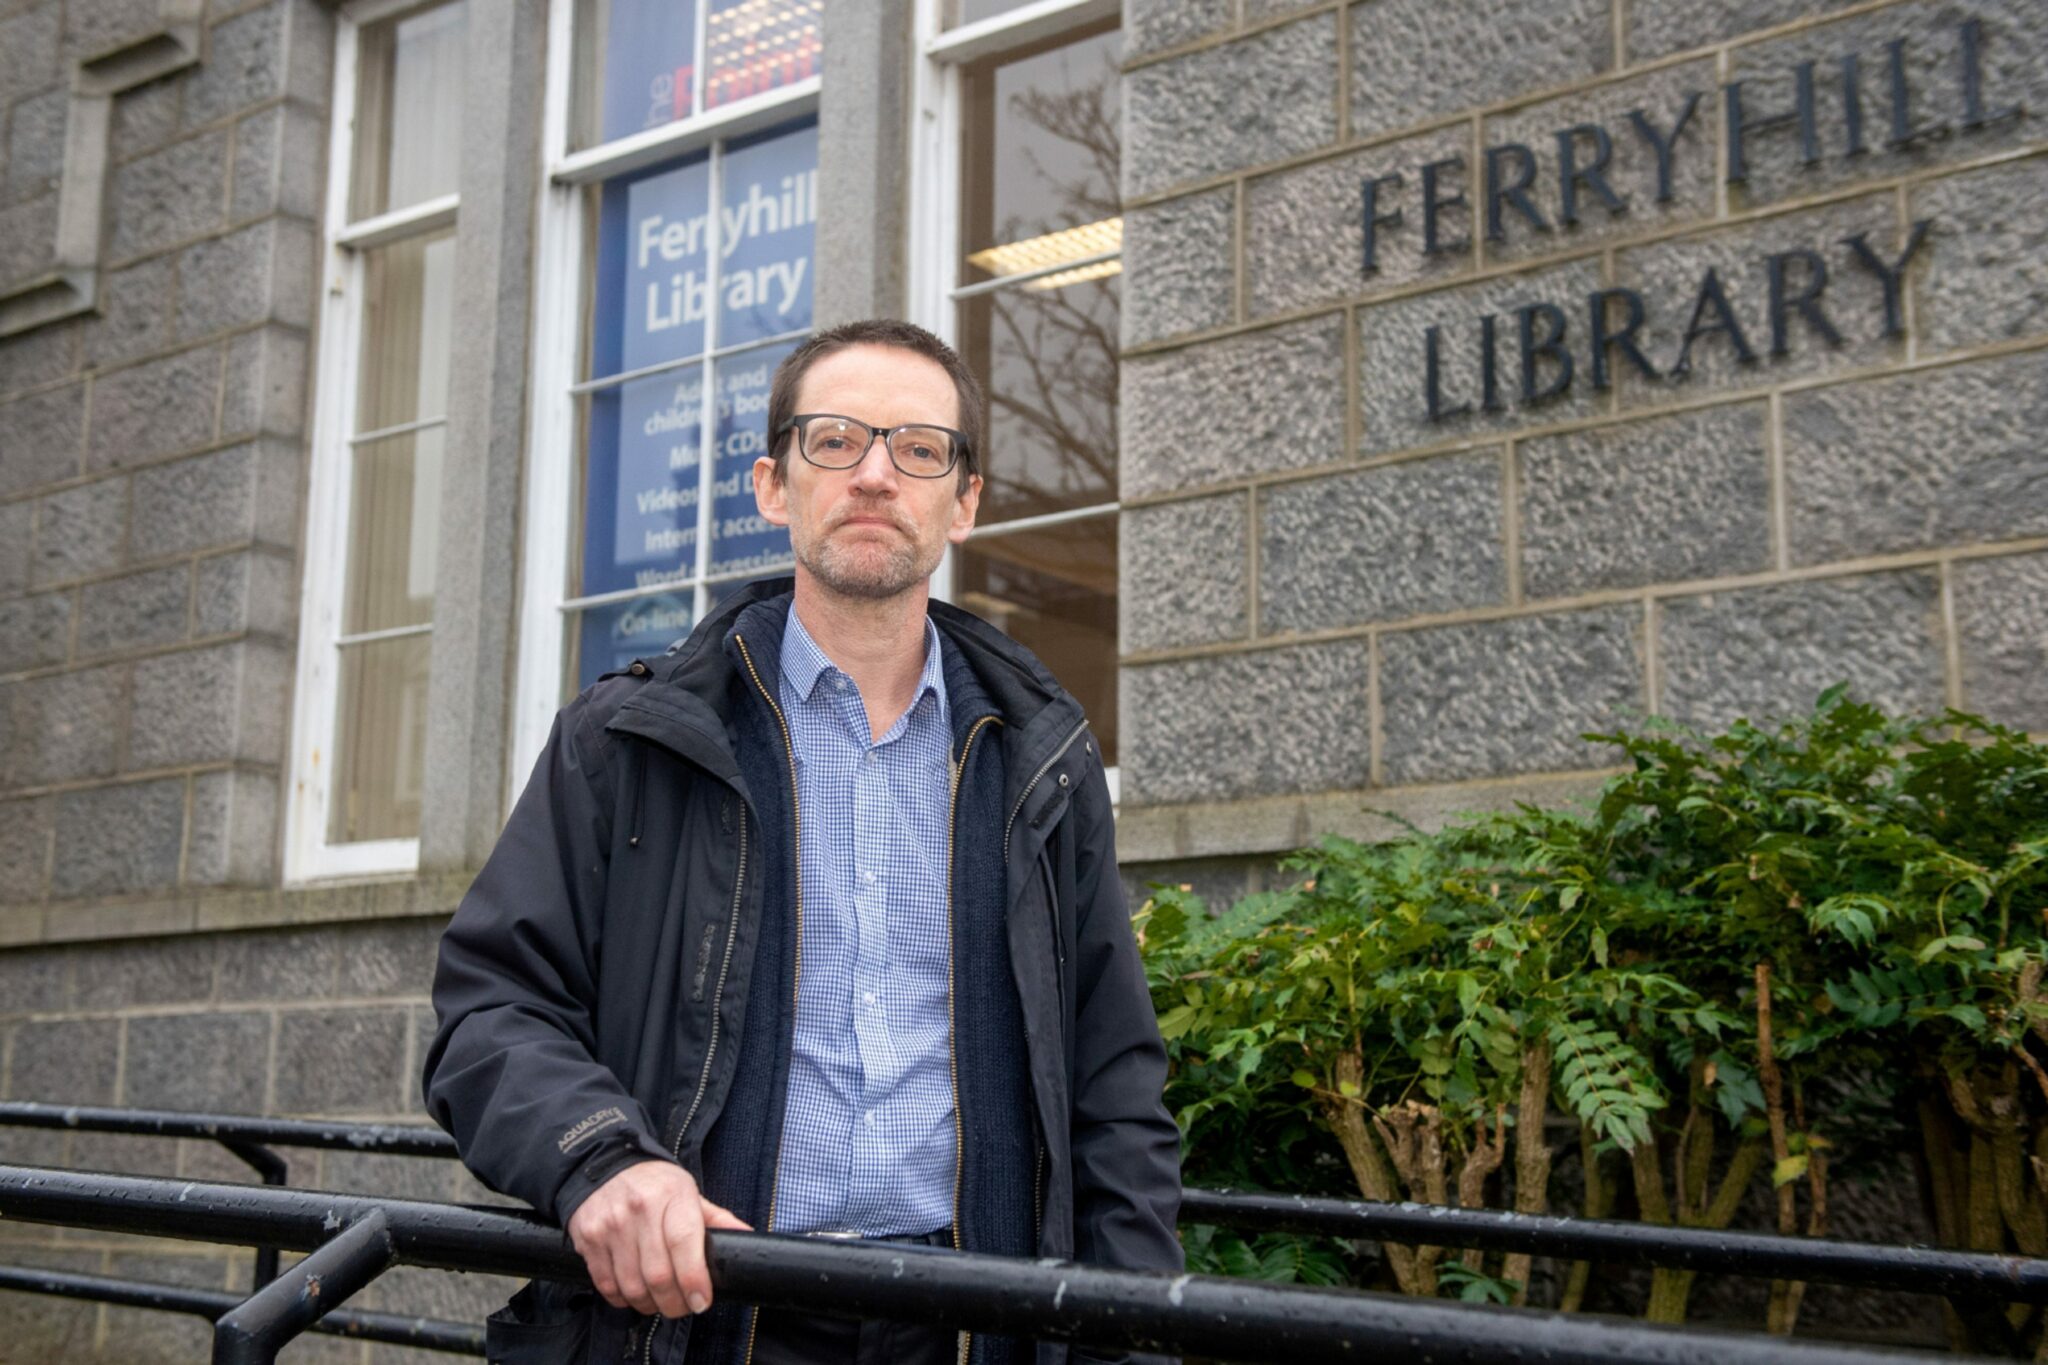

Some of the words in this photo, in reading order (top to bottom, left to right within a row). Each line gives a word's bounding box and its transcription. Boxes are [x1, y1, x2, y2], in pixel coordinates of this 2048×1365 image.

[1361, 19, 2026, 275] FERRYHILL
[638, 168, 818, 268] Feryhill
[1424, 218, 1934, 423] LIBRARY
[674, 376, 725, 405] Adt
[727, 363, 767, 393] and
[734, 392, 771, 416] boo
[669, 440, 724, 469] Muc
[713, 471, 740, 499] nd
[645, 520, 719, 553] Internt
[722, 515, 784, 538] acce
